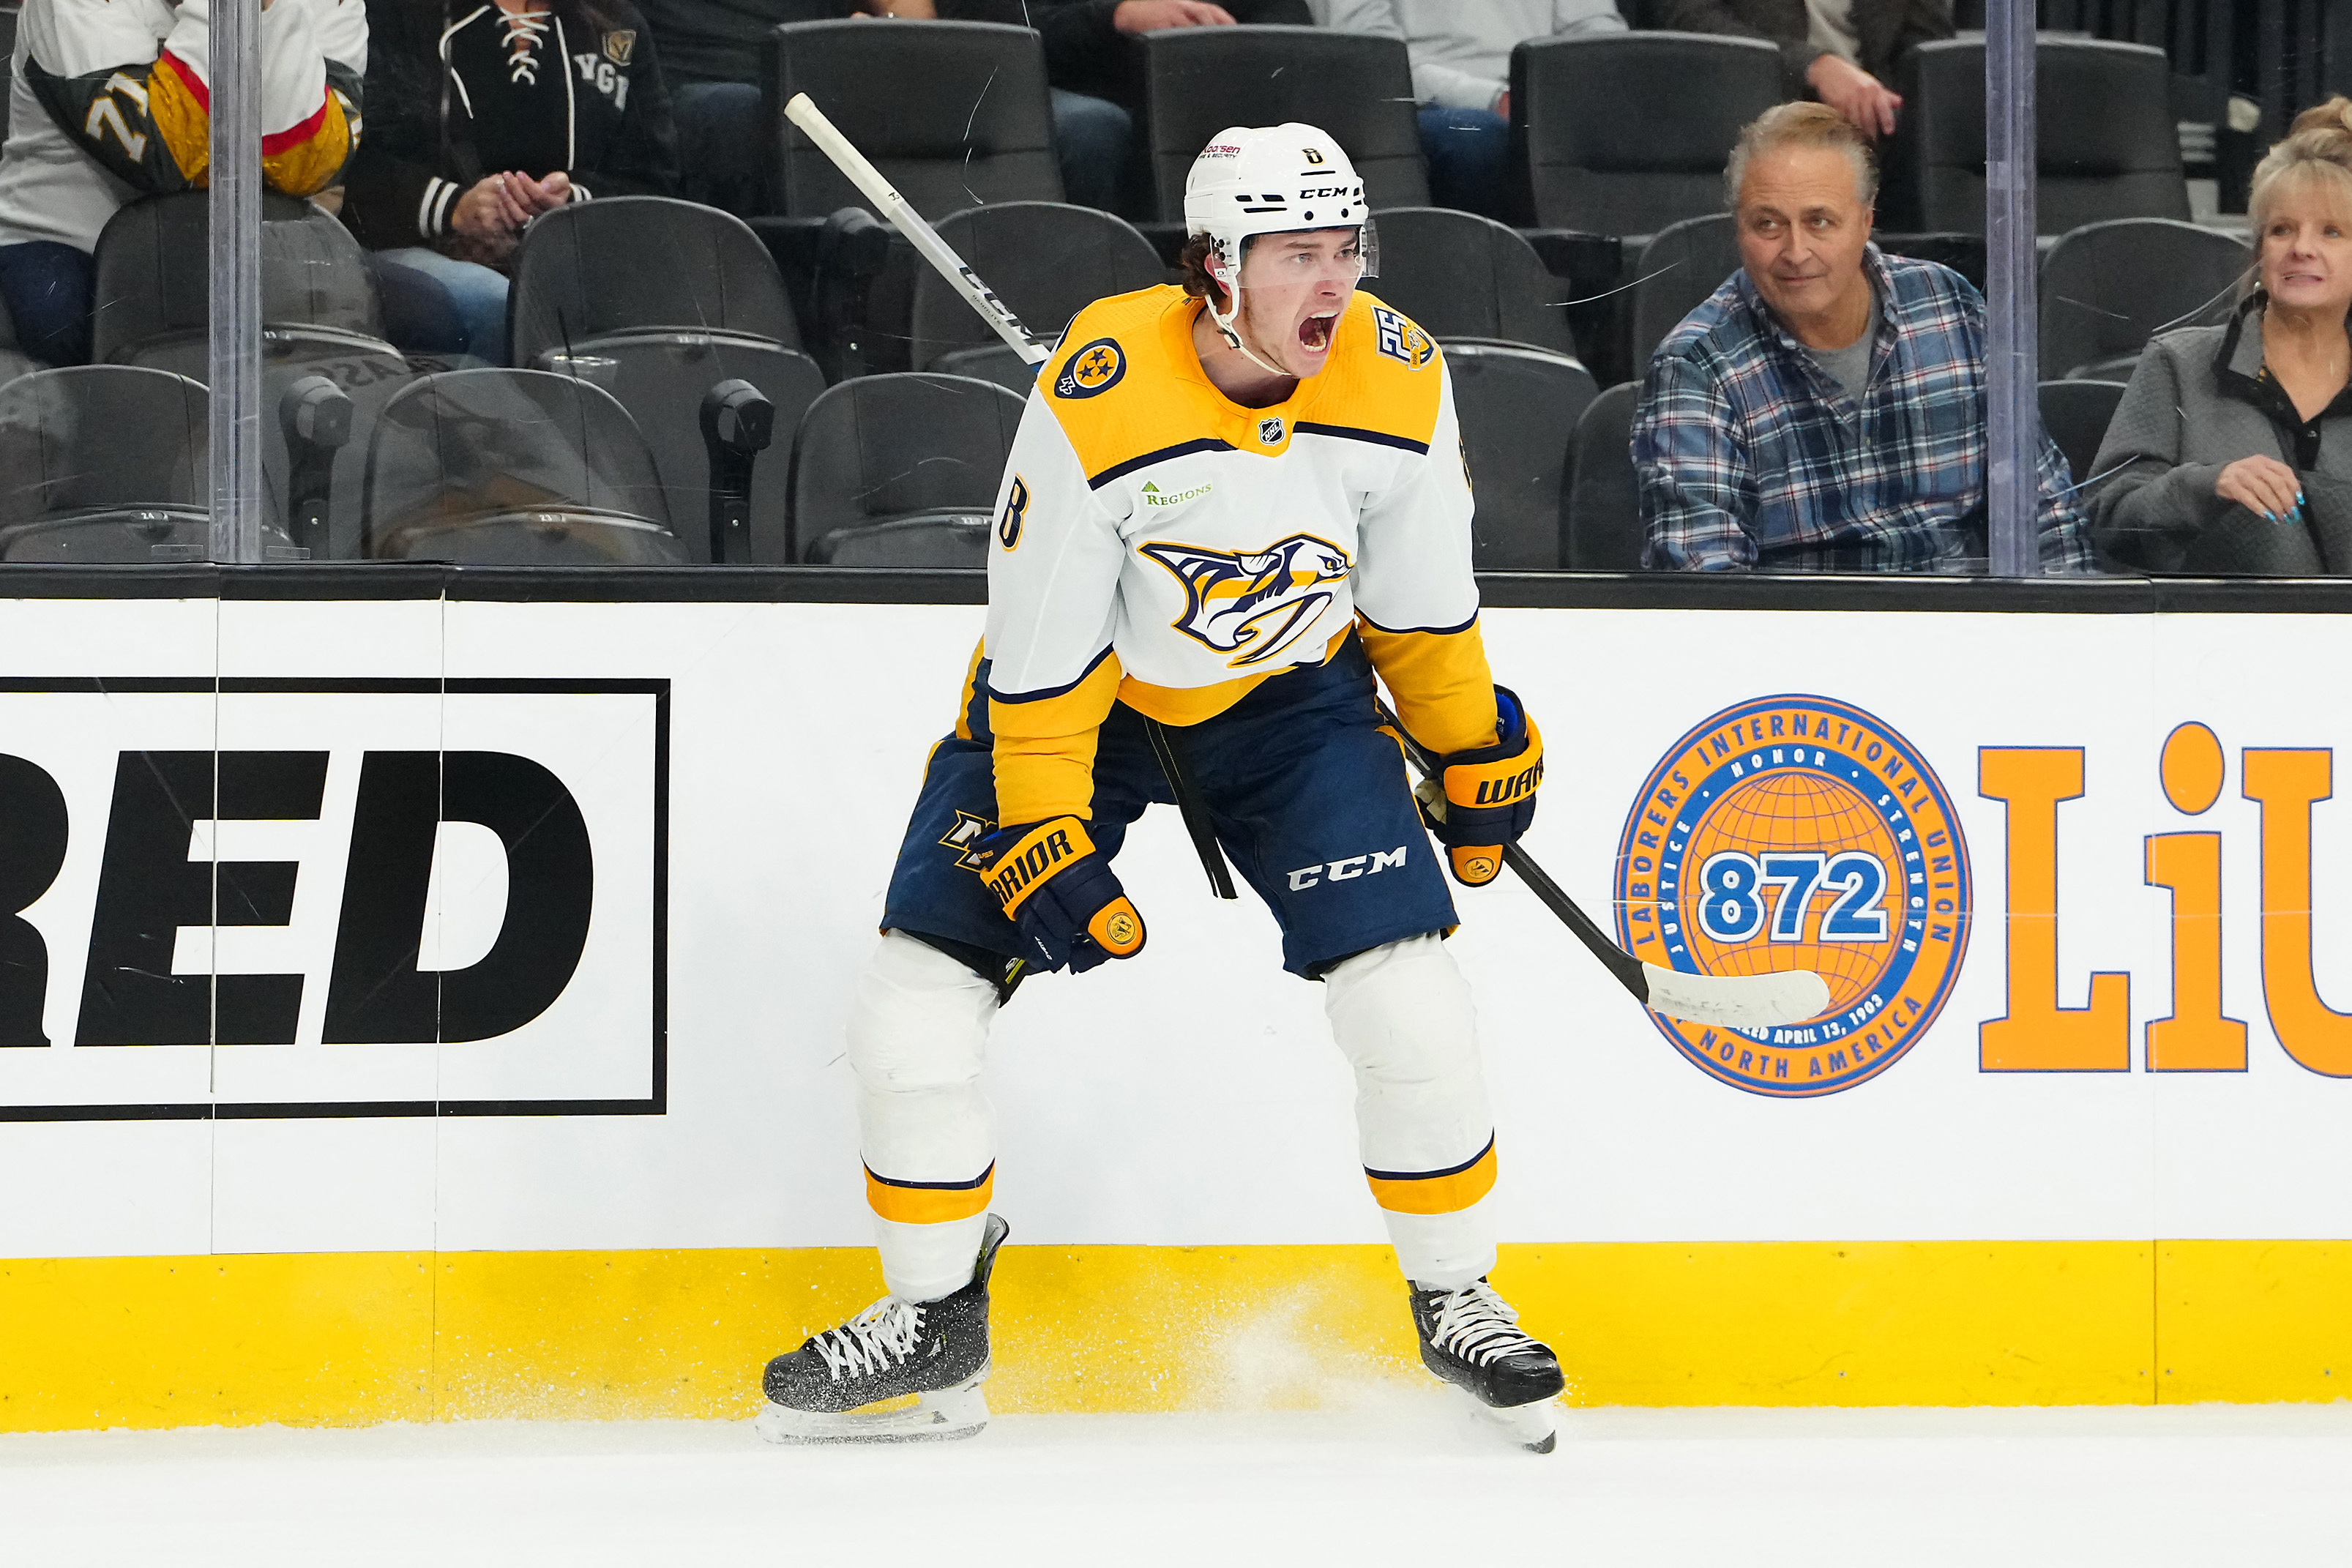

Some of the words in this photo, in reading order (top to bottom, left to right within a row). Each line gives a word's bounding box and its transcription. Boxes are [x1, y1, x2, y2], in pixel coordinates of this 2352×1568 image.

[1299, 187, 1348, 199] CCM
[1264, 423, 1280, 441] NHL
[998, 472, 1031, 553] 8
[1731, 748, 1826, 777] HONOR
[1286, 845, 1407, 892] CCM
[1631, 769, 1690, 945] LABORERS
[1697, 714, 1929, 814] INTERNATIONAL
[1926, 829, 1954, 943] UNION
[1661, 821, 1690, 953] JUSTICE
[1698, 850, 1889, 944] 872
[1878, 794, 1924, 952] STRENGTH
[1699, 1028, 1788, 1078] NORTH
[1809, 996, 1922, 1078] AMERICA
[1774, 1028, 1818, 1045] APRIL
[1821, 1022, 1847, 1039] 13,
[1848, 993, 1884, 1025] 1903
